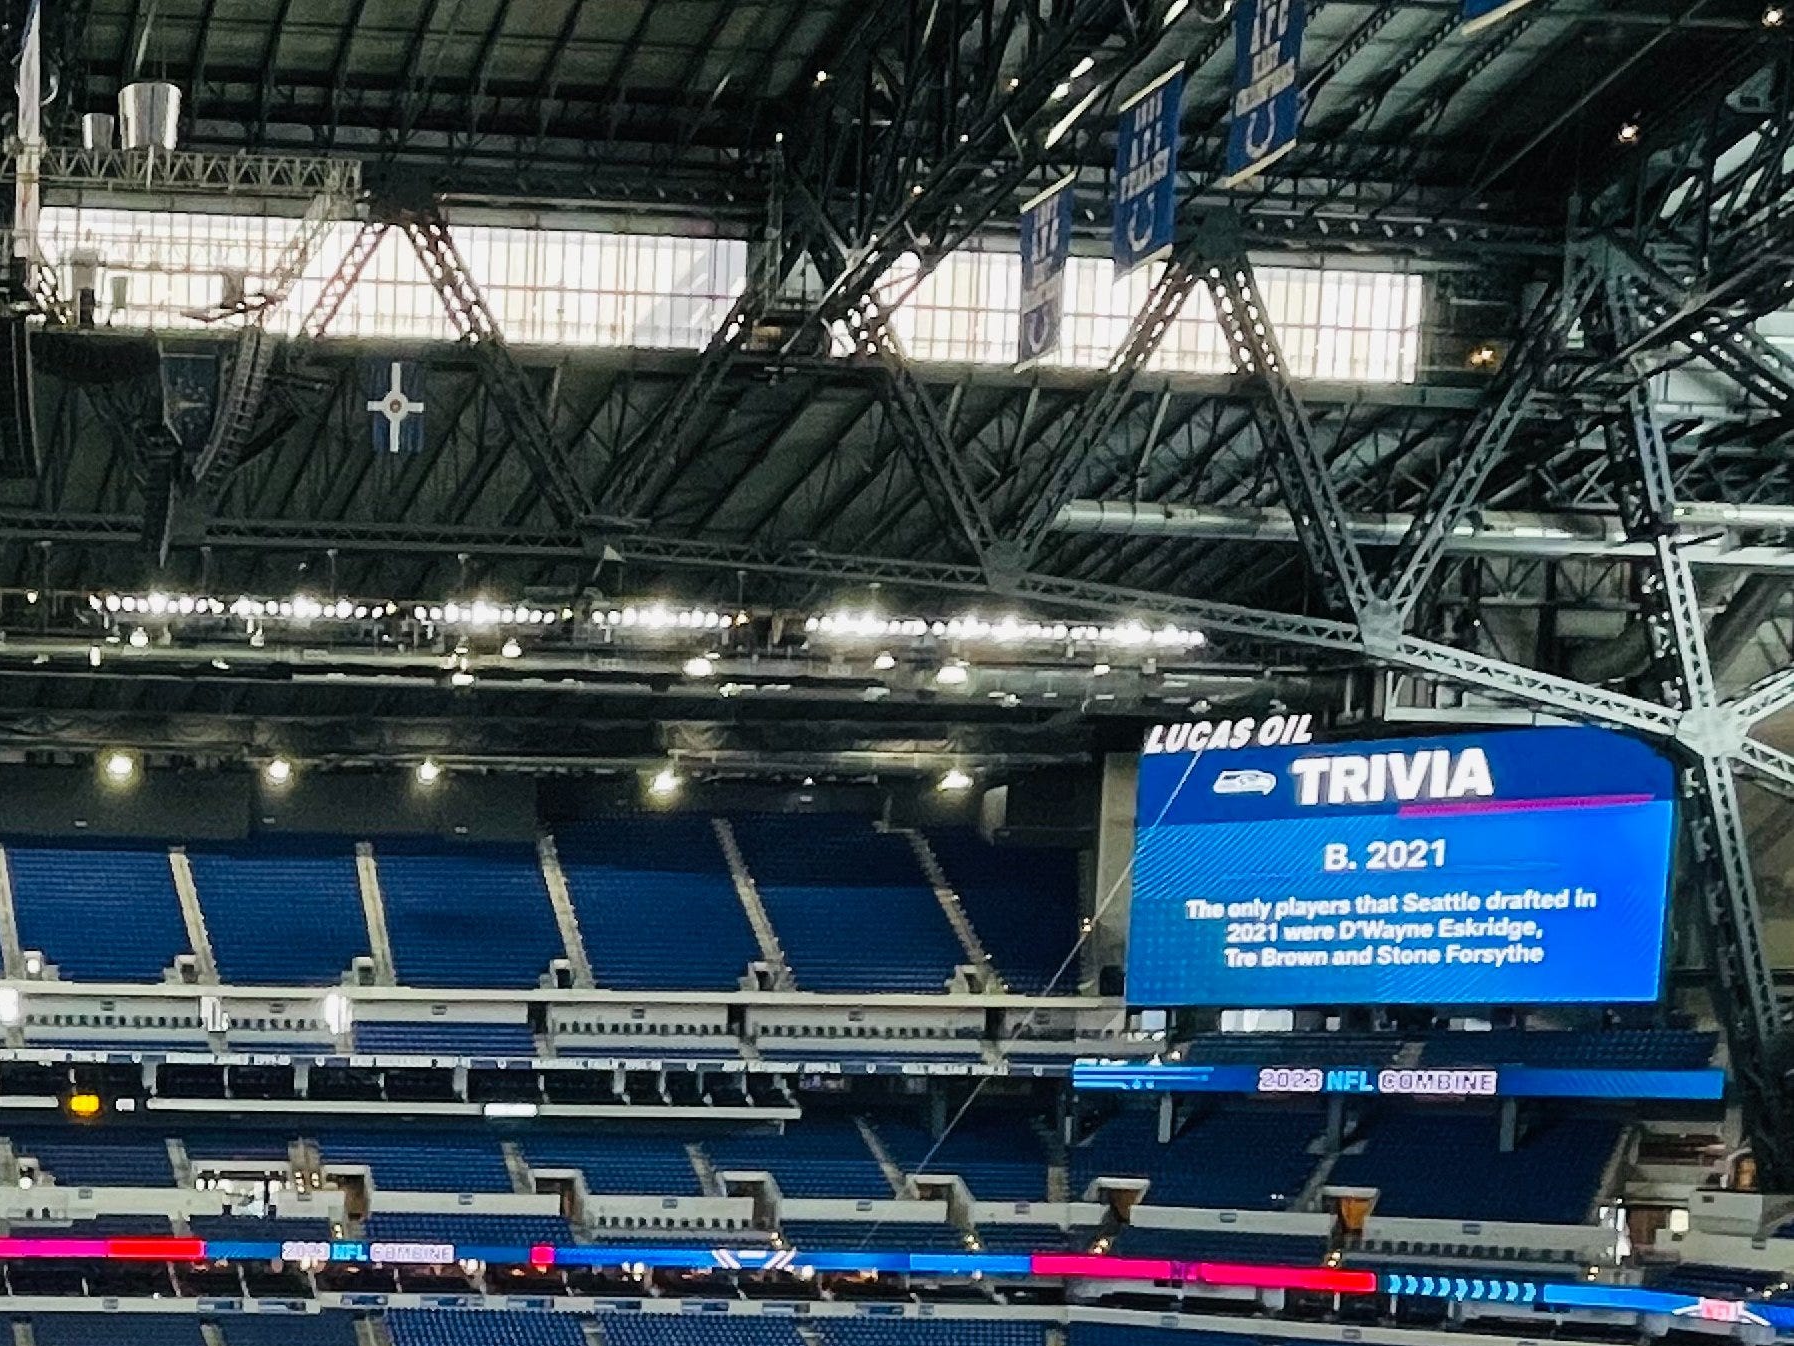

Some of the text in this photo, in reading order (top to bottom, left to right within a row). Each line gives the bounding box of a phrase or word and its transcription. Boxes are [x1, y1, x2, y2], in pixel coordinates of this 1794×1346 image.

[1144, 713, 1313, 754] LUCAS OIL
[1292, 748, 1494, 805] TRIVIA
[1324, 839, 1446, 871] B. 2021
[1186, 888, 1597, 922] The only players that Seattle drafted in
[1225, 916, 1543, 944] 2021 were D'Wayne Eskridge,
[1224, 942, 1545, 968] Tre Brown and Stone Forsythe
[1258, 1068, 1497, 1095] 2023 NFL COMBINE
[332, 1243, 368, 1261] NFL
[370, 1242, 455, 1263] COMBINE
